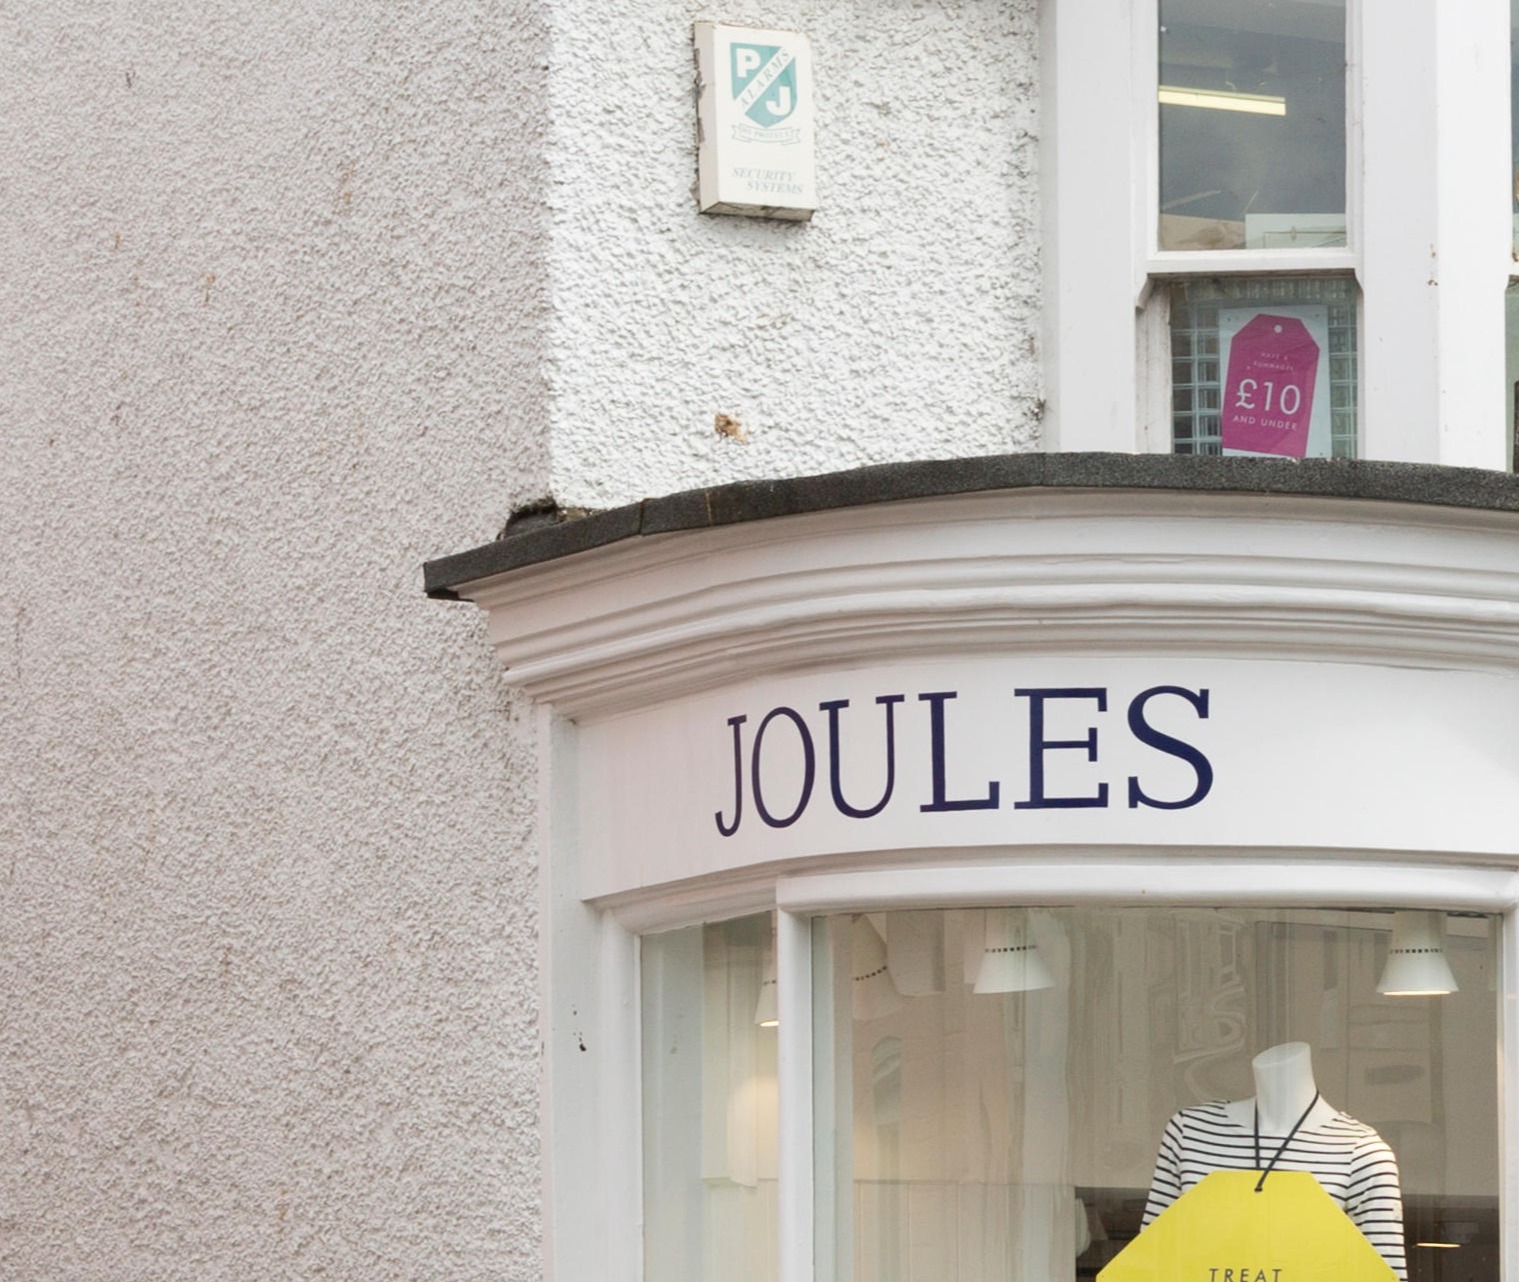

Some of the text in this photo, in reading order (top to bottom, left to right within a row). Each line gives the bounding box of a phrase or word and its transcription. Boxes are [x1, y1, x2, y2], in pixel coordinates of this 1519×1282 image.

[736, 48, 761, 78] P
[740, 48, 793, 108] ALARMS
[766, 86, 791, 116] J
[732, 168, 794, 181] SECURITY
[746, 181, 804, 194] SYSTEMS
[1235, 378, 1300, 415] £10
[1233, 415, 1297, 430] AND UNDER
[714, 685, 1215, 838] JOULES
